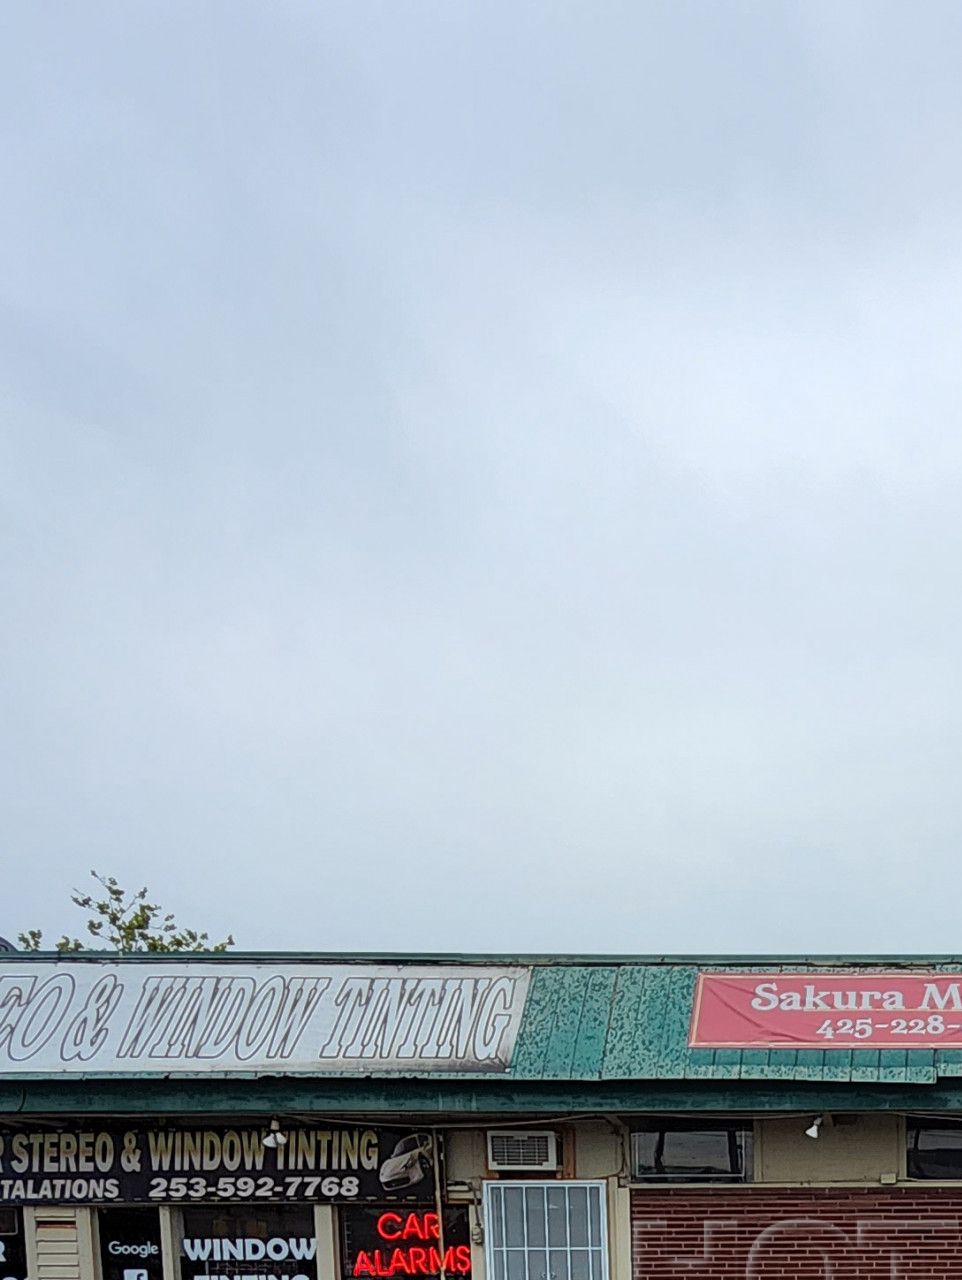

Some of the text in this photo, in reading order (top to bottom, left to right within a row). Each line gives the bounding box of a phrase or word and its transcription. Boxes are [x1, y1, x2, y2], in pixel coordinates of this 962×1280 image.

[750, 982, 905, 1012] Sakura
[60, 974, 125, 1062] &
[116, 974, 333, 1060] WINDOW
[320, 975, 516, 1062] TINTING
[10, 1132, 114, 1173] STEREO
[120, 1131, 141, 1172] &
[148, 1130, 267, 1172] WINDOW
[275, 1130, 379, 1172] TINTING
[148, 1176, 359, 1198] 253-592-7768
[377, 1212, 440, 1240] CAR
[108, 1240, 159, 1258] Google
[183, 1237, 318, 1261] WINDOW
[352, 1245, 471, 1277] ALARMS
